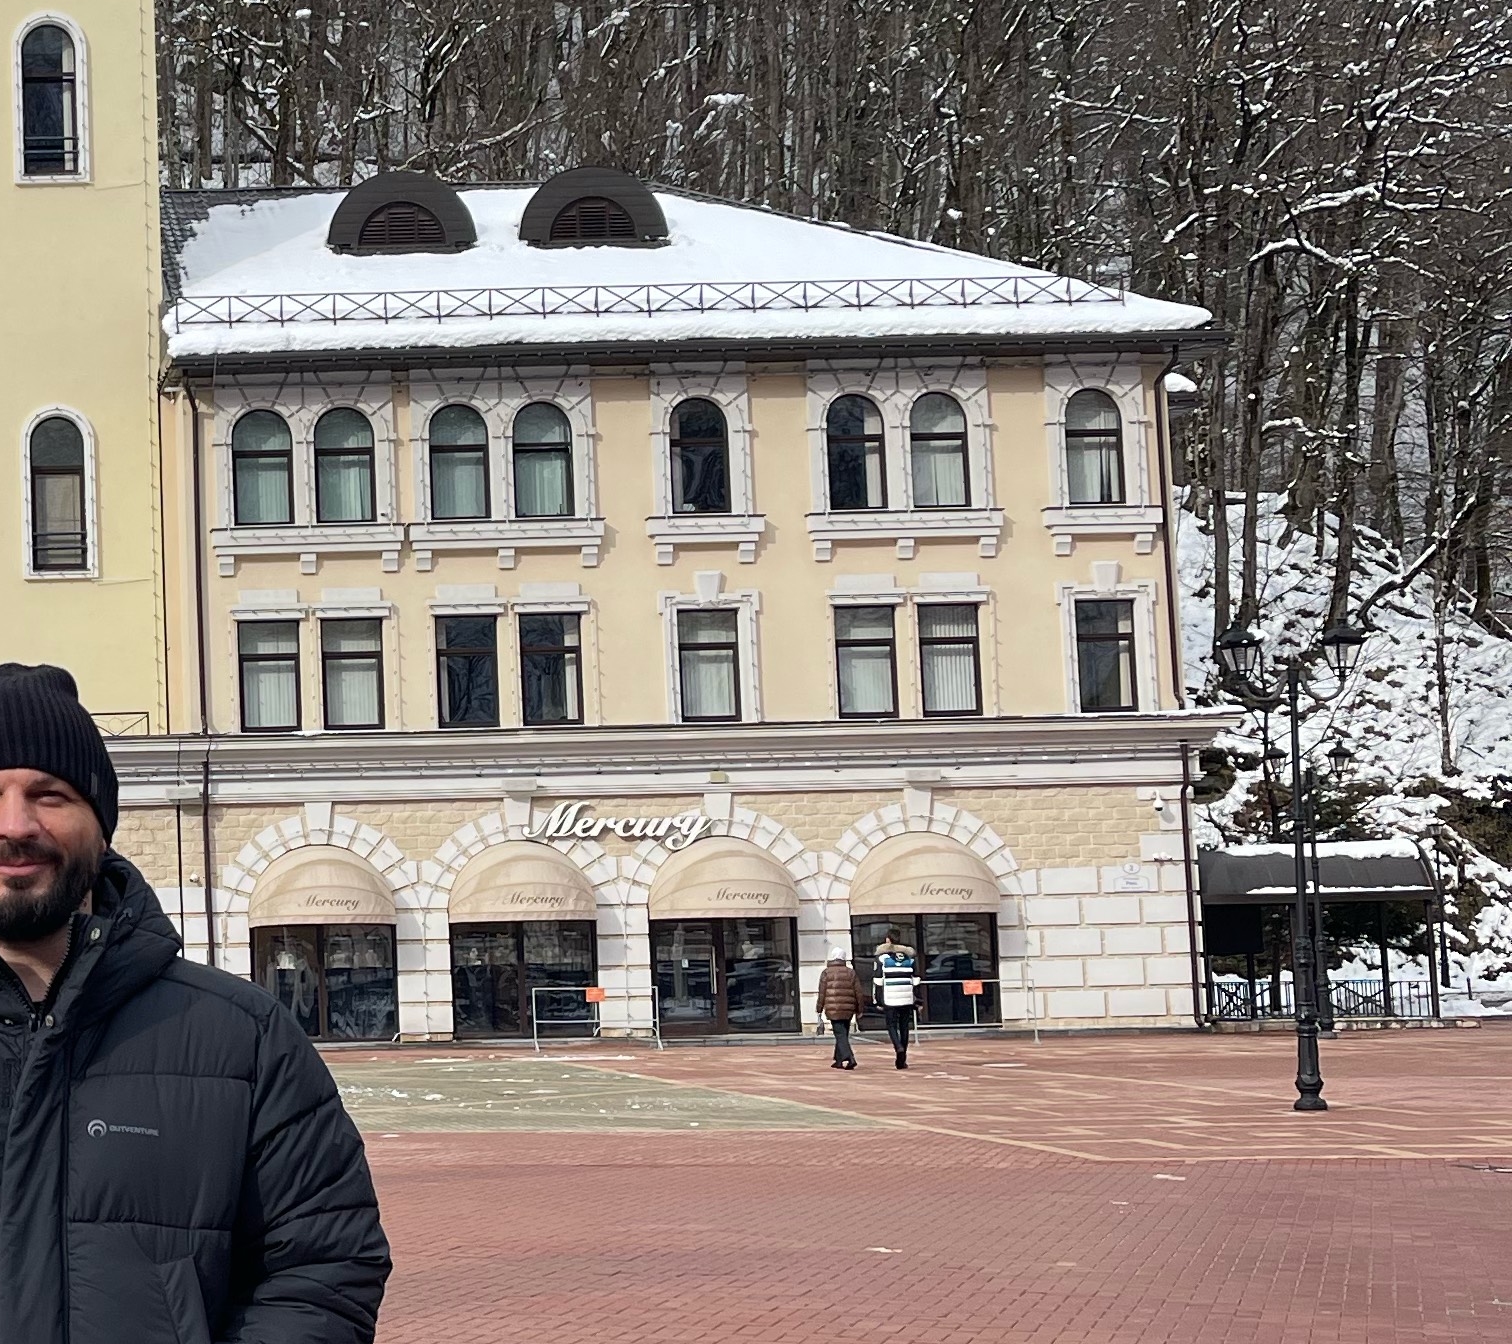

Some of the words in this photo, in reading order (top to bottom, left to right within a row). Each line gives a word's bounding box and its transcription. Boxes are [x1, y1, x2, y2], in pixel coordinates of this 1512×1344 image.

[522, 799, 713, 850] Mercury
[502, 890, 564, 908] Mercury
[707, 887, 770, 905] Mercury
[911, 881, 973, 900] Mercury
[298, 894, 360, 911] Mercury
[109, 1124, 159, 1136] OUTVENTURE
